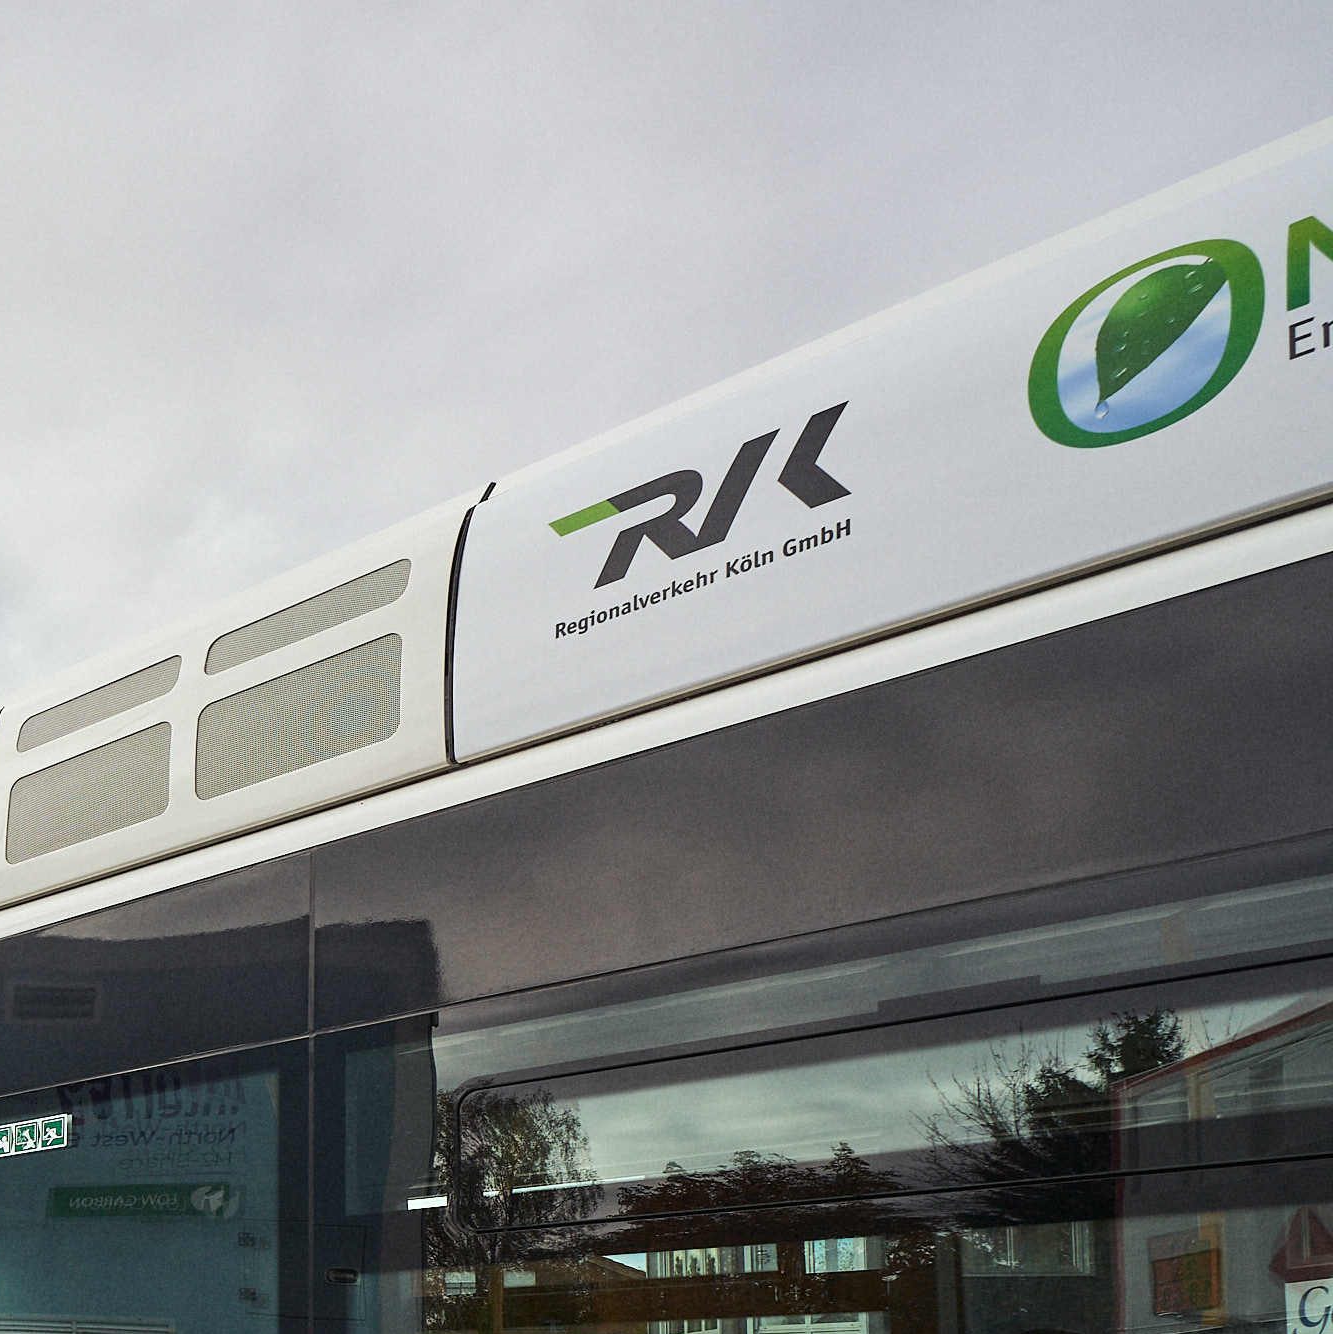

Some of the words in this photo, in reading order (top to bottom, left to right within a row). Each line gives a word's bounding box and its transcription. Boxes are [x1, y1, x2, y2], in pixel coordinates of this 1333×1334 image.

[548, 401, 852, 590] RVK
[555, 570, 718, 639] Regionalverkehr
[725, 550, 774, 579] Köln
[782, 519, 851, 557] GmbH
